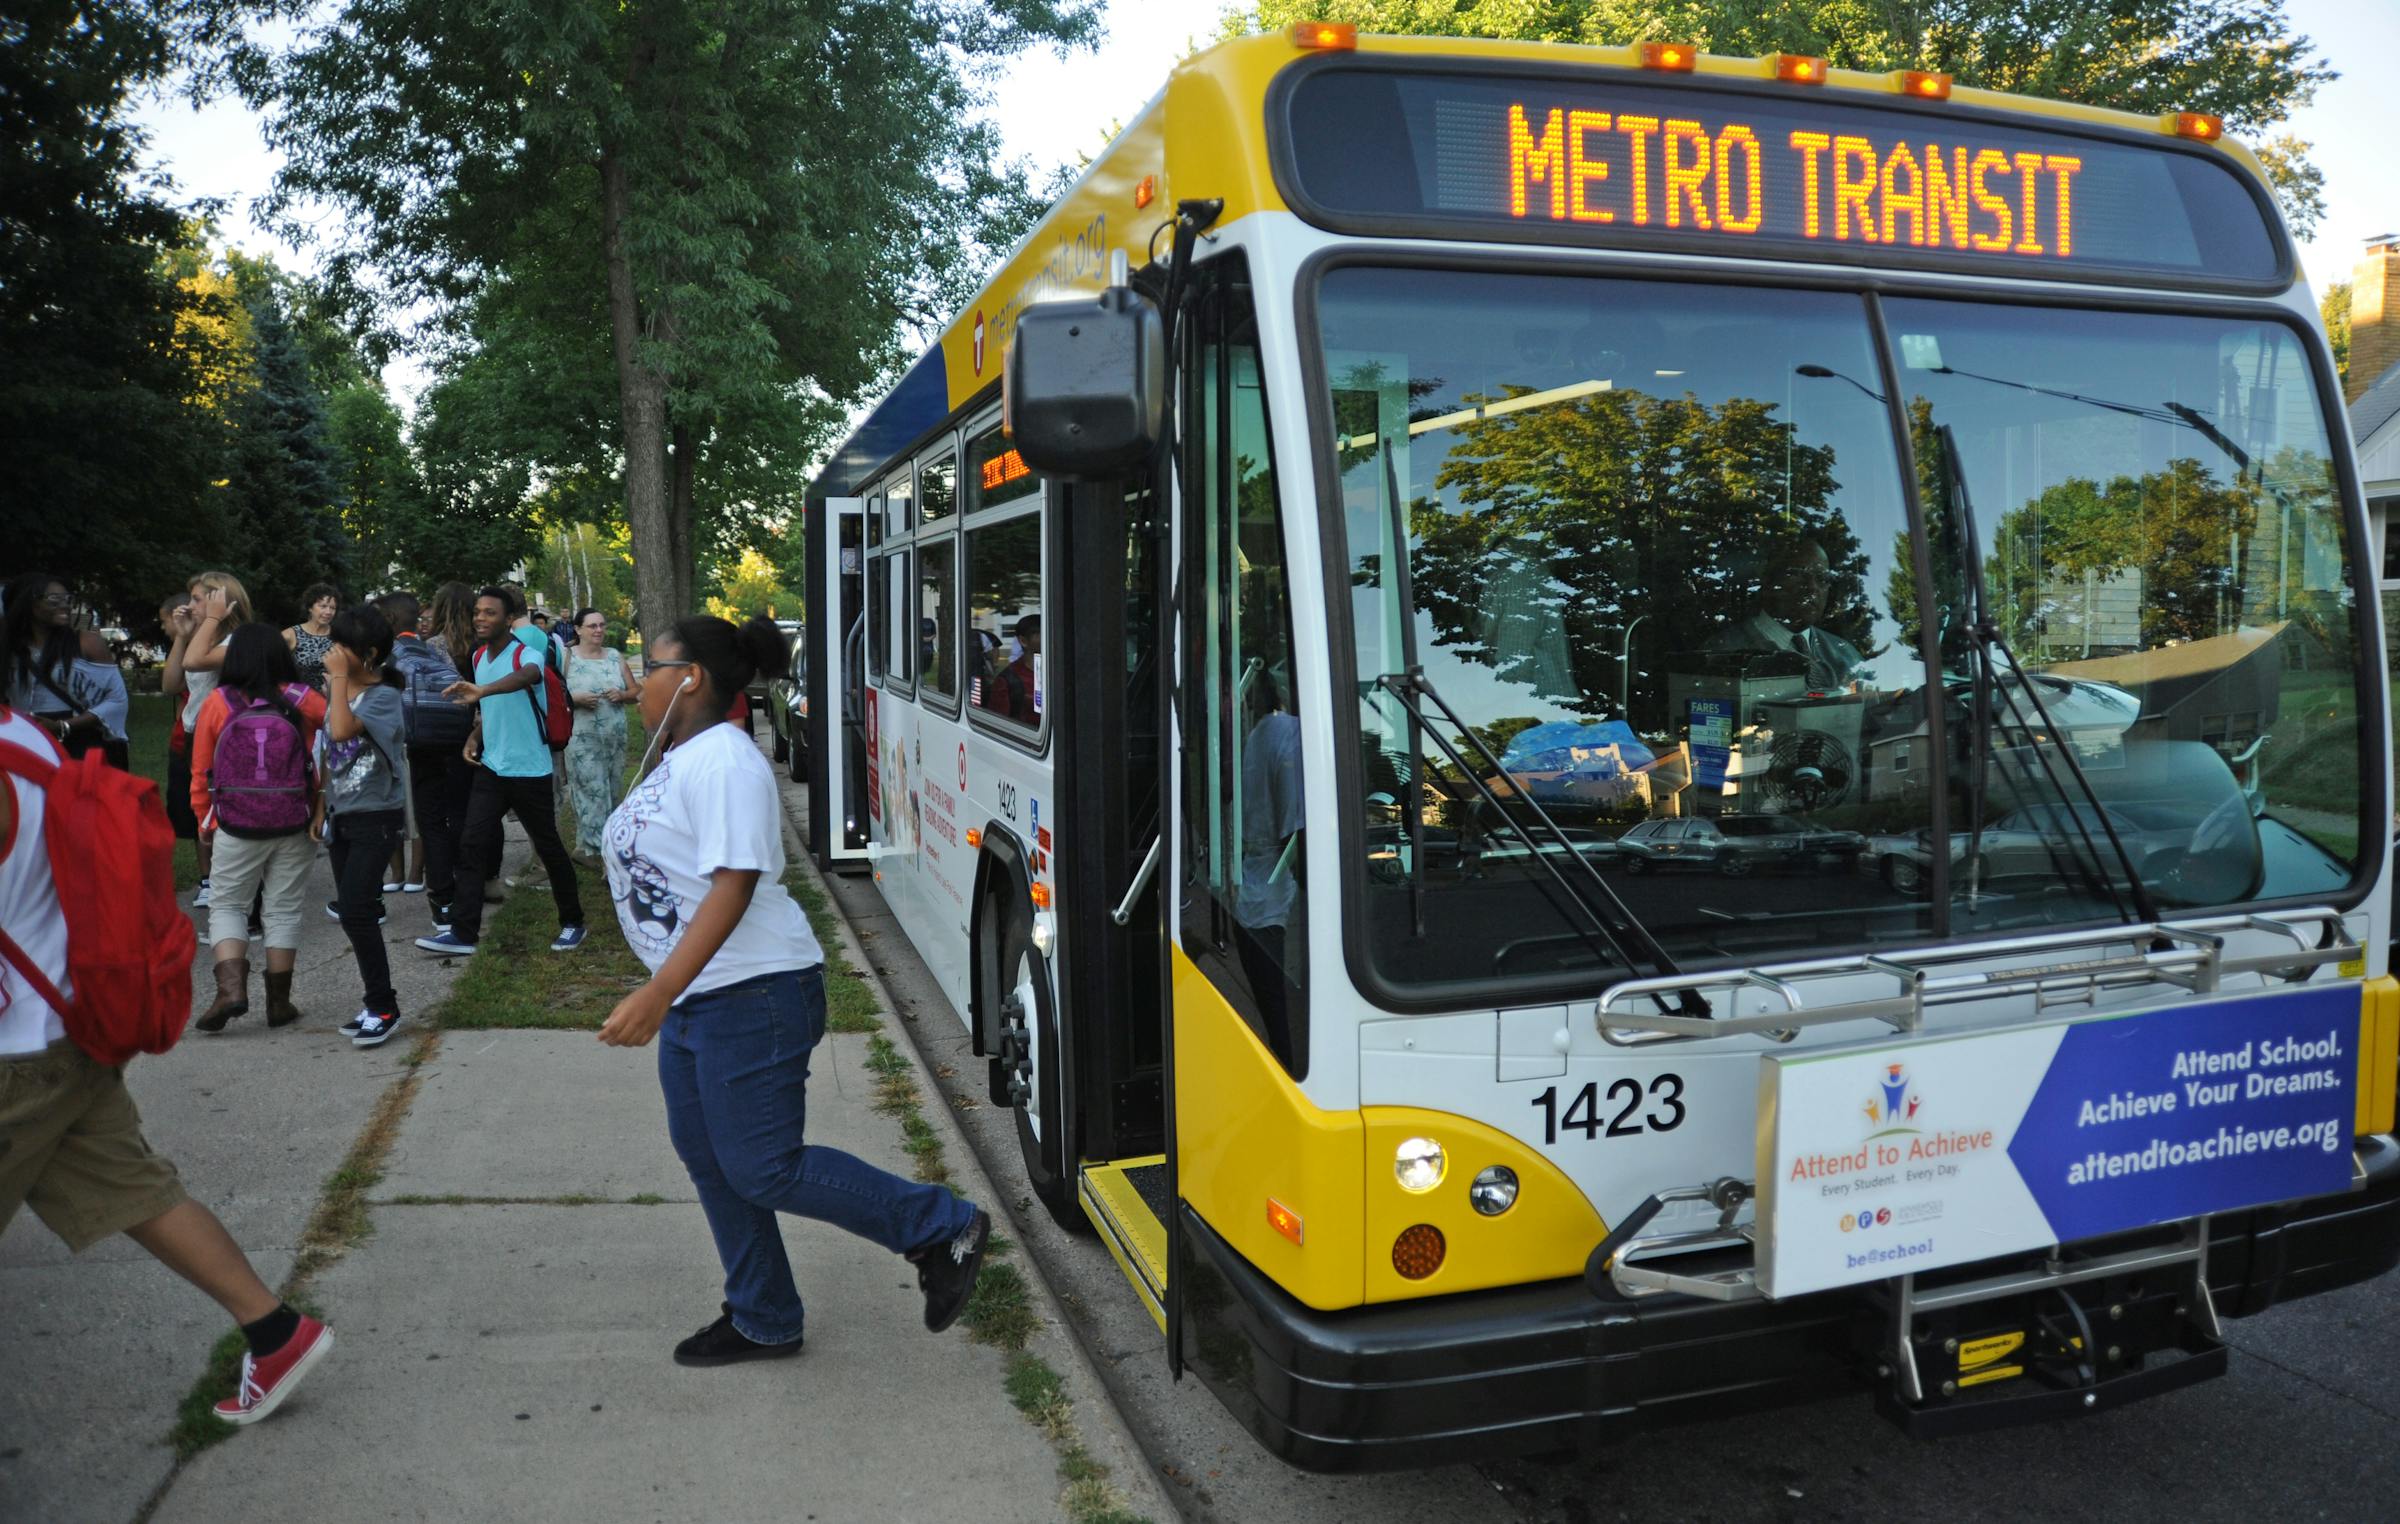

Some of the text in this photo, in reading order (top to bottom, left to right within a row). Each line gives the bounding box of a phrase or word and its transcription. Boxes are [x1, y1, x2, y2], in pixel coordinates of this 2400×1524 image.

[1509, 104, 2081, 257] METRO TRANSIT
[1691, 702, 1720, 714] FARES
[998, 779, 1016, 822] 1423
[2171, 1030, 2343, 1079] Attend School.
[1531, 1073, 1686, 1145] 1423
[2078, 1069, 2341, 1127] Achieve Your Dreams.
[1791, 1130, 1993, 1182] Attend to Achieve
[2067, 1118, 2339, 1185] attendtoachieve.org
[1821, 1164, 1961, 1197] Every Student. Every Day.
[1847, 1239, 1934, 1268] be@school
